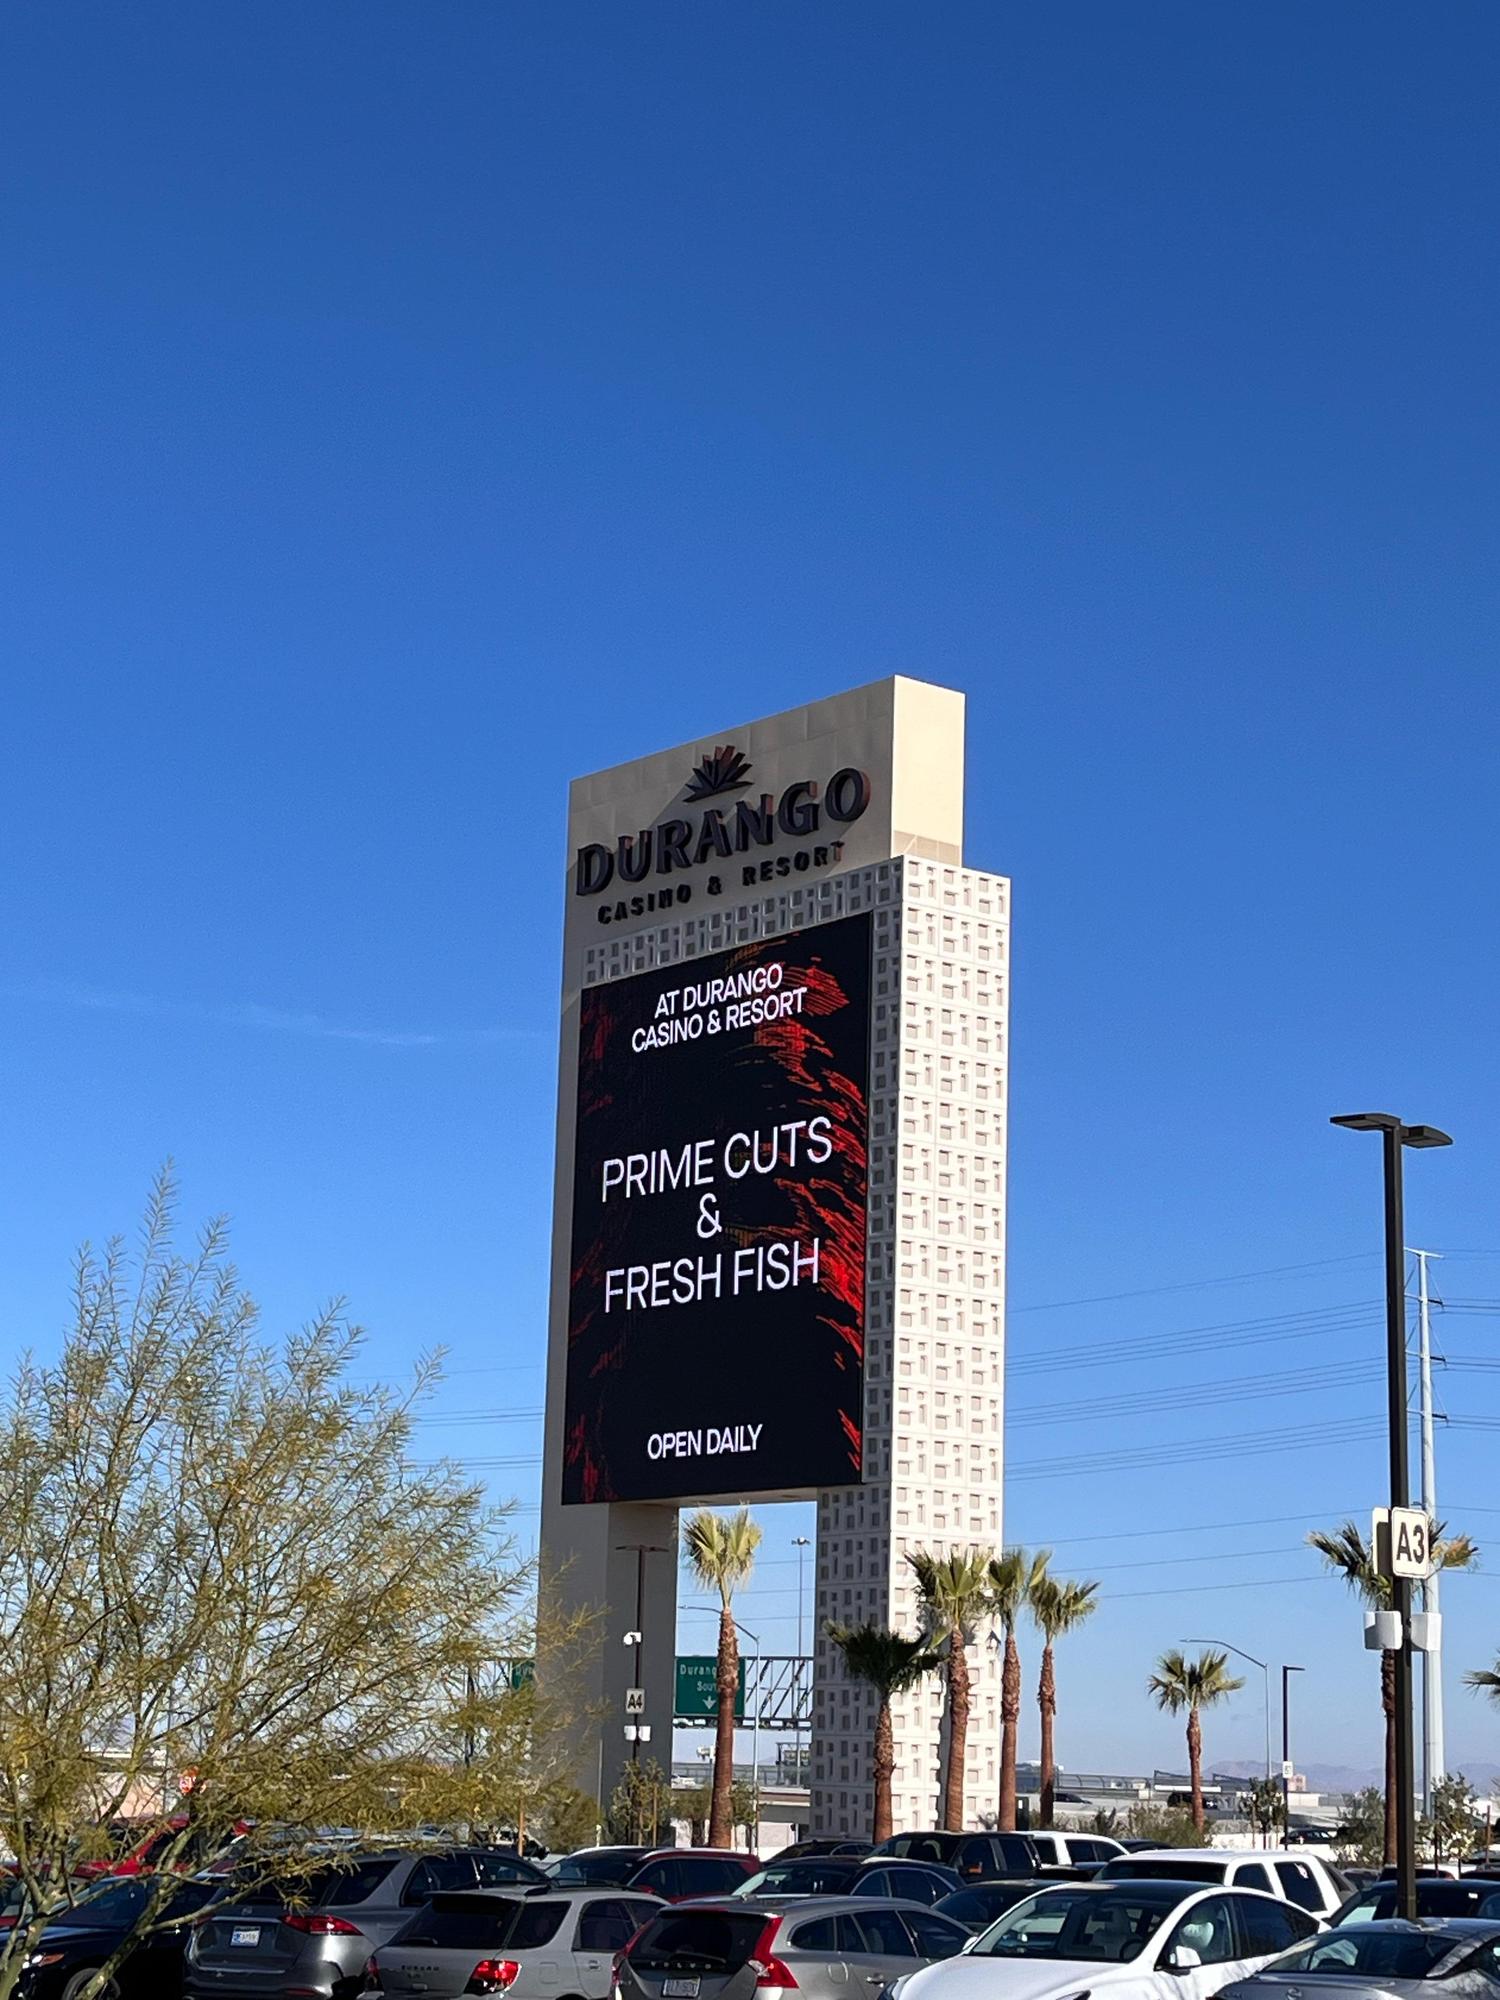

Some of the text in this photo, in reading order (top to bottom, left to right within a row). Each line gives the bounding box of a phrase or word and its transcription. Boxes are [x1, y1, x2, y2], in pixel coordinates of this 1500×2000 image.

[577, 768, 870, 895] DURANGO
[598, 841, 845, 924] CASINO & RESORT
[655, 964, 783, 1018] AT DURANGO
[632, 987, 807, 1052] CASINO & RESORT
[602, 1116, 832, 1202] PRIME CUTS
[697, 1192, 722, 1238] &
[605, 1237, 819, 1313] FRESH FISH
[647, 1424, 763, 1459] OPEN DAILY
[1396, 1522, 1425, 1564] A3
[680, 1664, 717, 1679] Durang
[628, 1694, 643, 1709] A4
